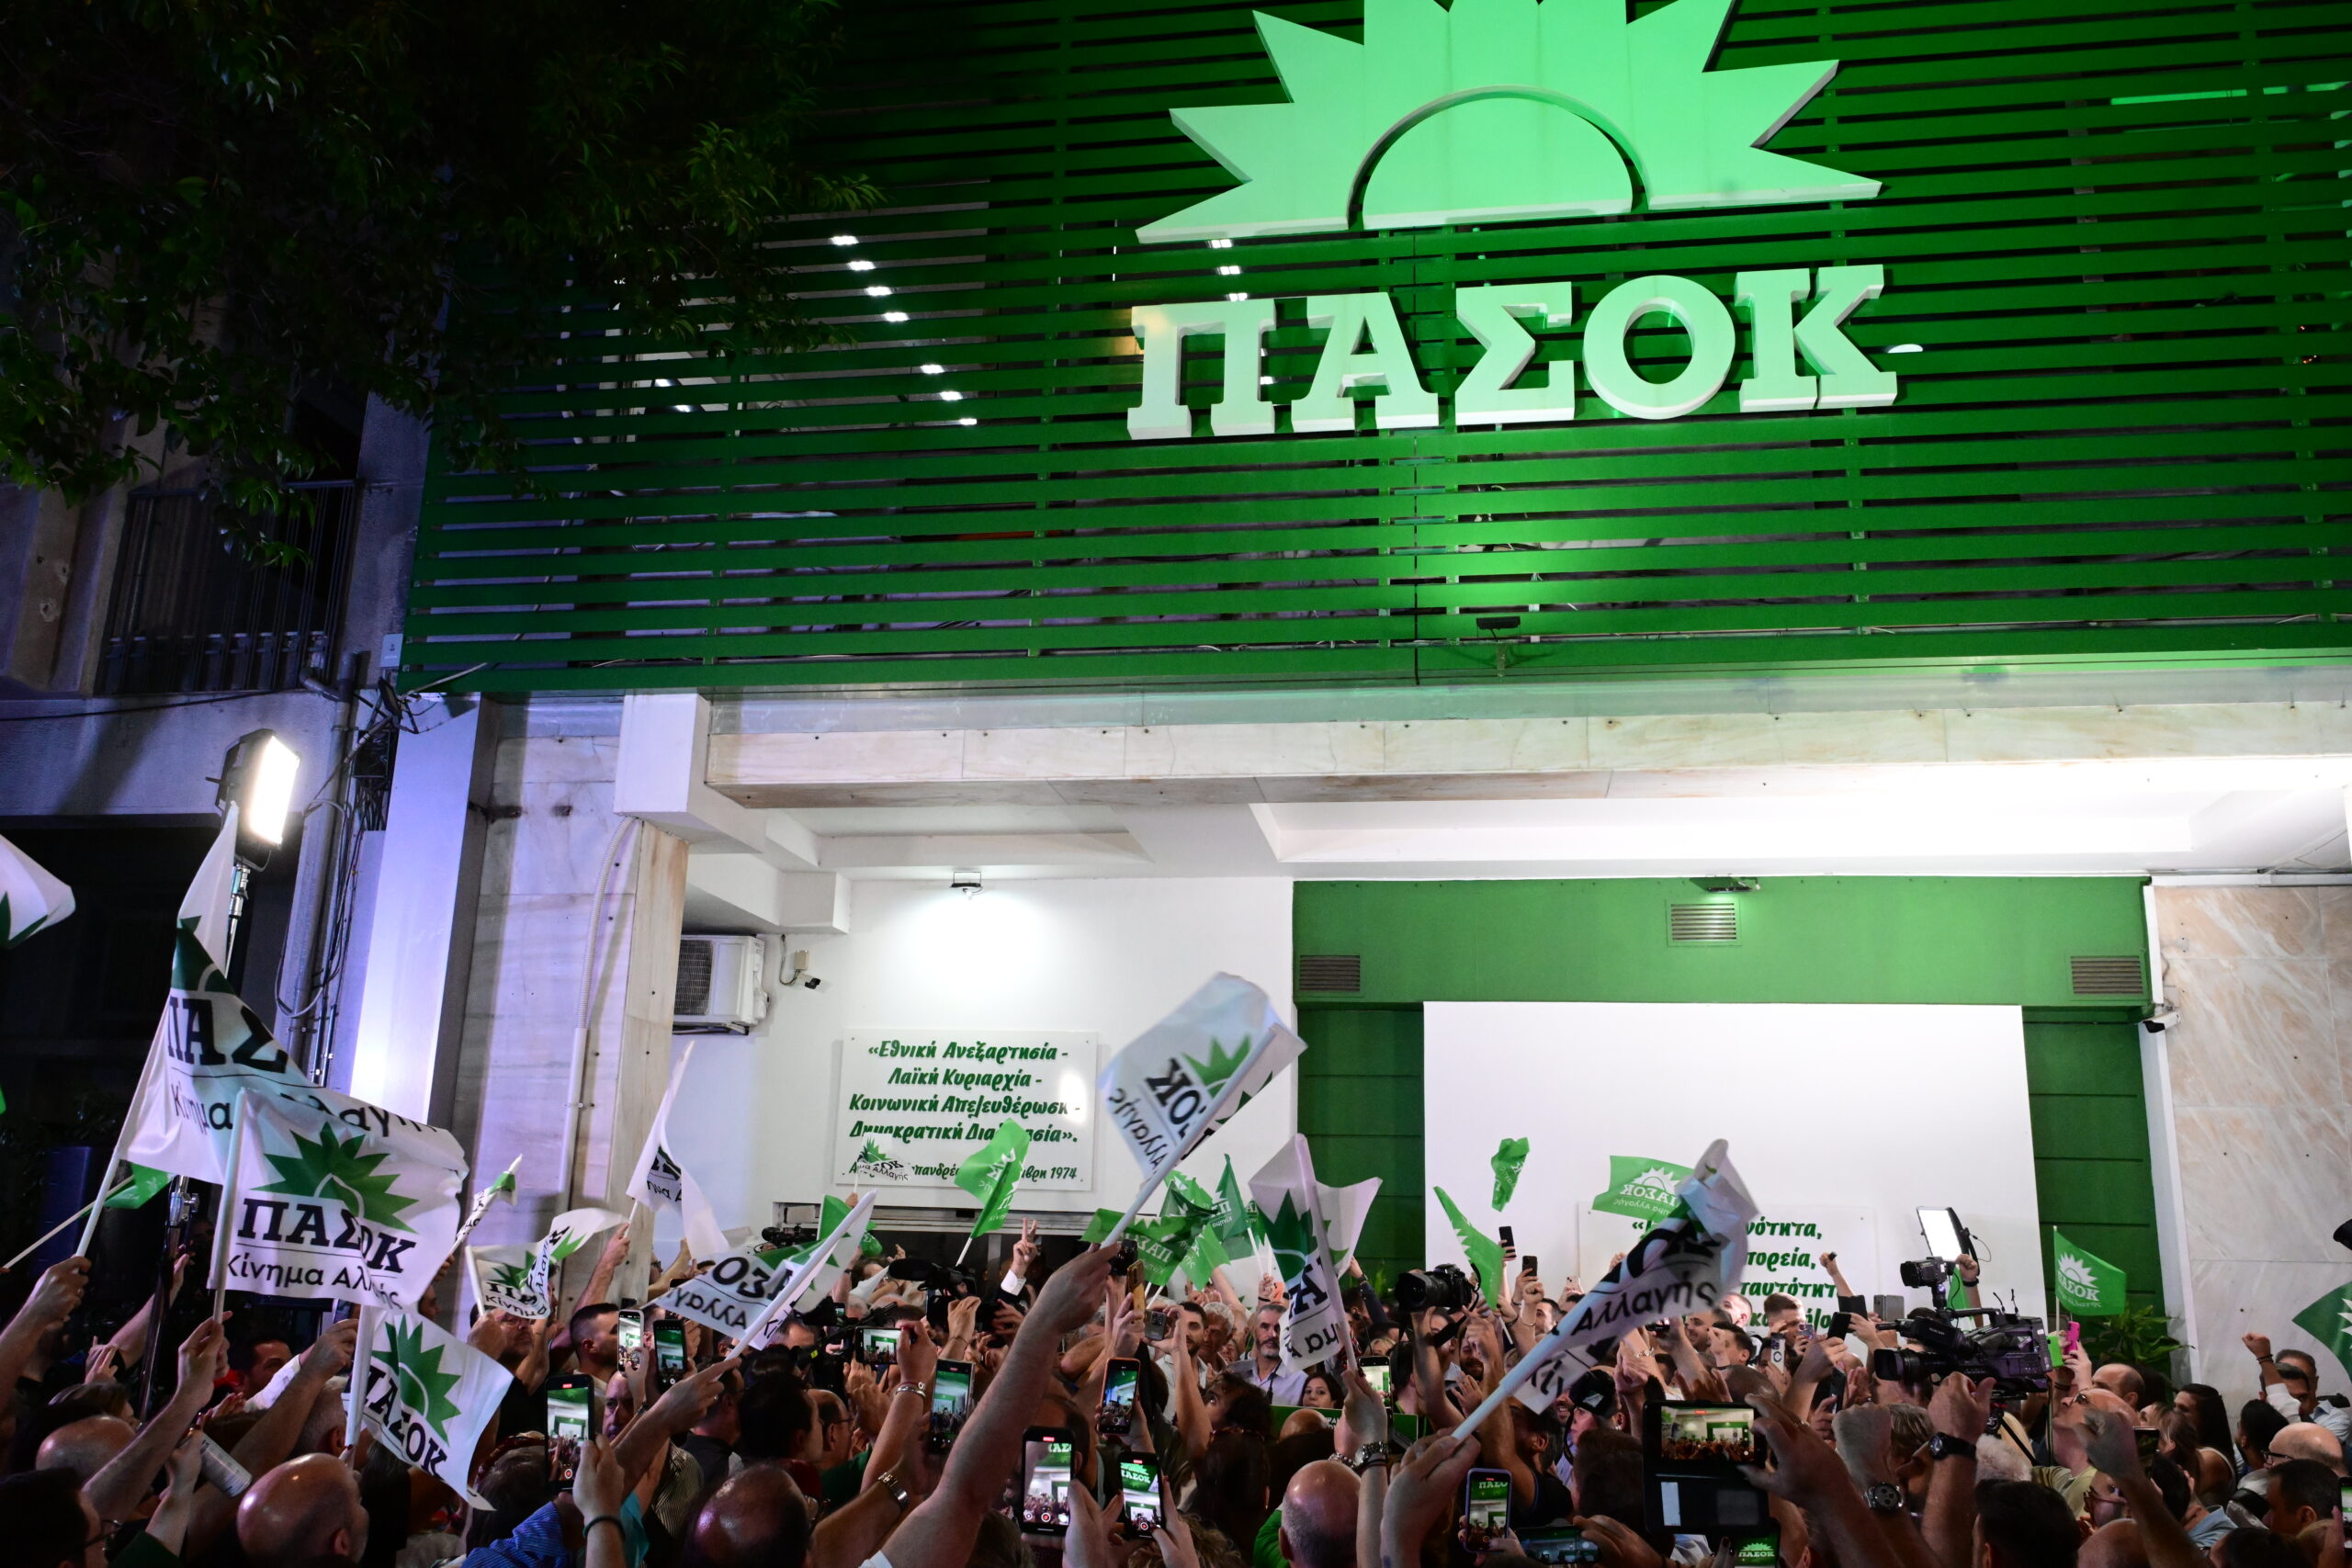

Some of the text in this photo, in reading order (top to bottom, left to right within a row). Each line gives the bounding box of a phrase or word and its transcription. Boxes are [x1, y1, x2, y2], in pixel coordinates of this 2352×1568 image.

[1127, 265, 1897, 440] ΠΑΣΟΚ
[168, 997, 288, 1073] ΠΑΣ
[868, 1040, 937, 1058] «Εθνική
[943, 1041, 1057, 1065] Ανεξαρτησία
[888, 1067, 938, 1086] Λαϊκή
[942, 1068, 1032, 1091] Κυριαρχία
[849, 1094, 939, 1111] Κοινωνική
[874, 1167, 909, 1181] Αλλαγής
[1050, 1167, 1077, 1179] 1974
[1746, 1216, 1822, 1240] νότητα,
[1571, 1270, 1718, 1336] Αλλαγής
